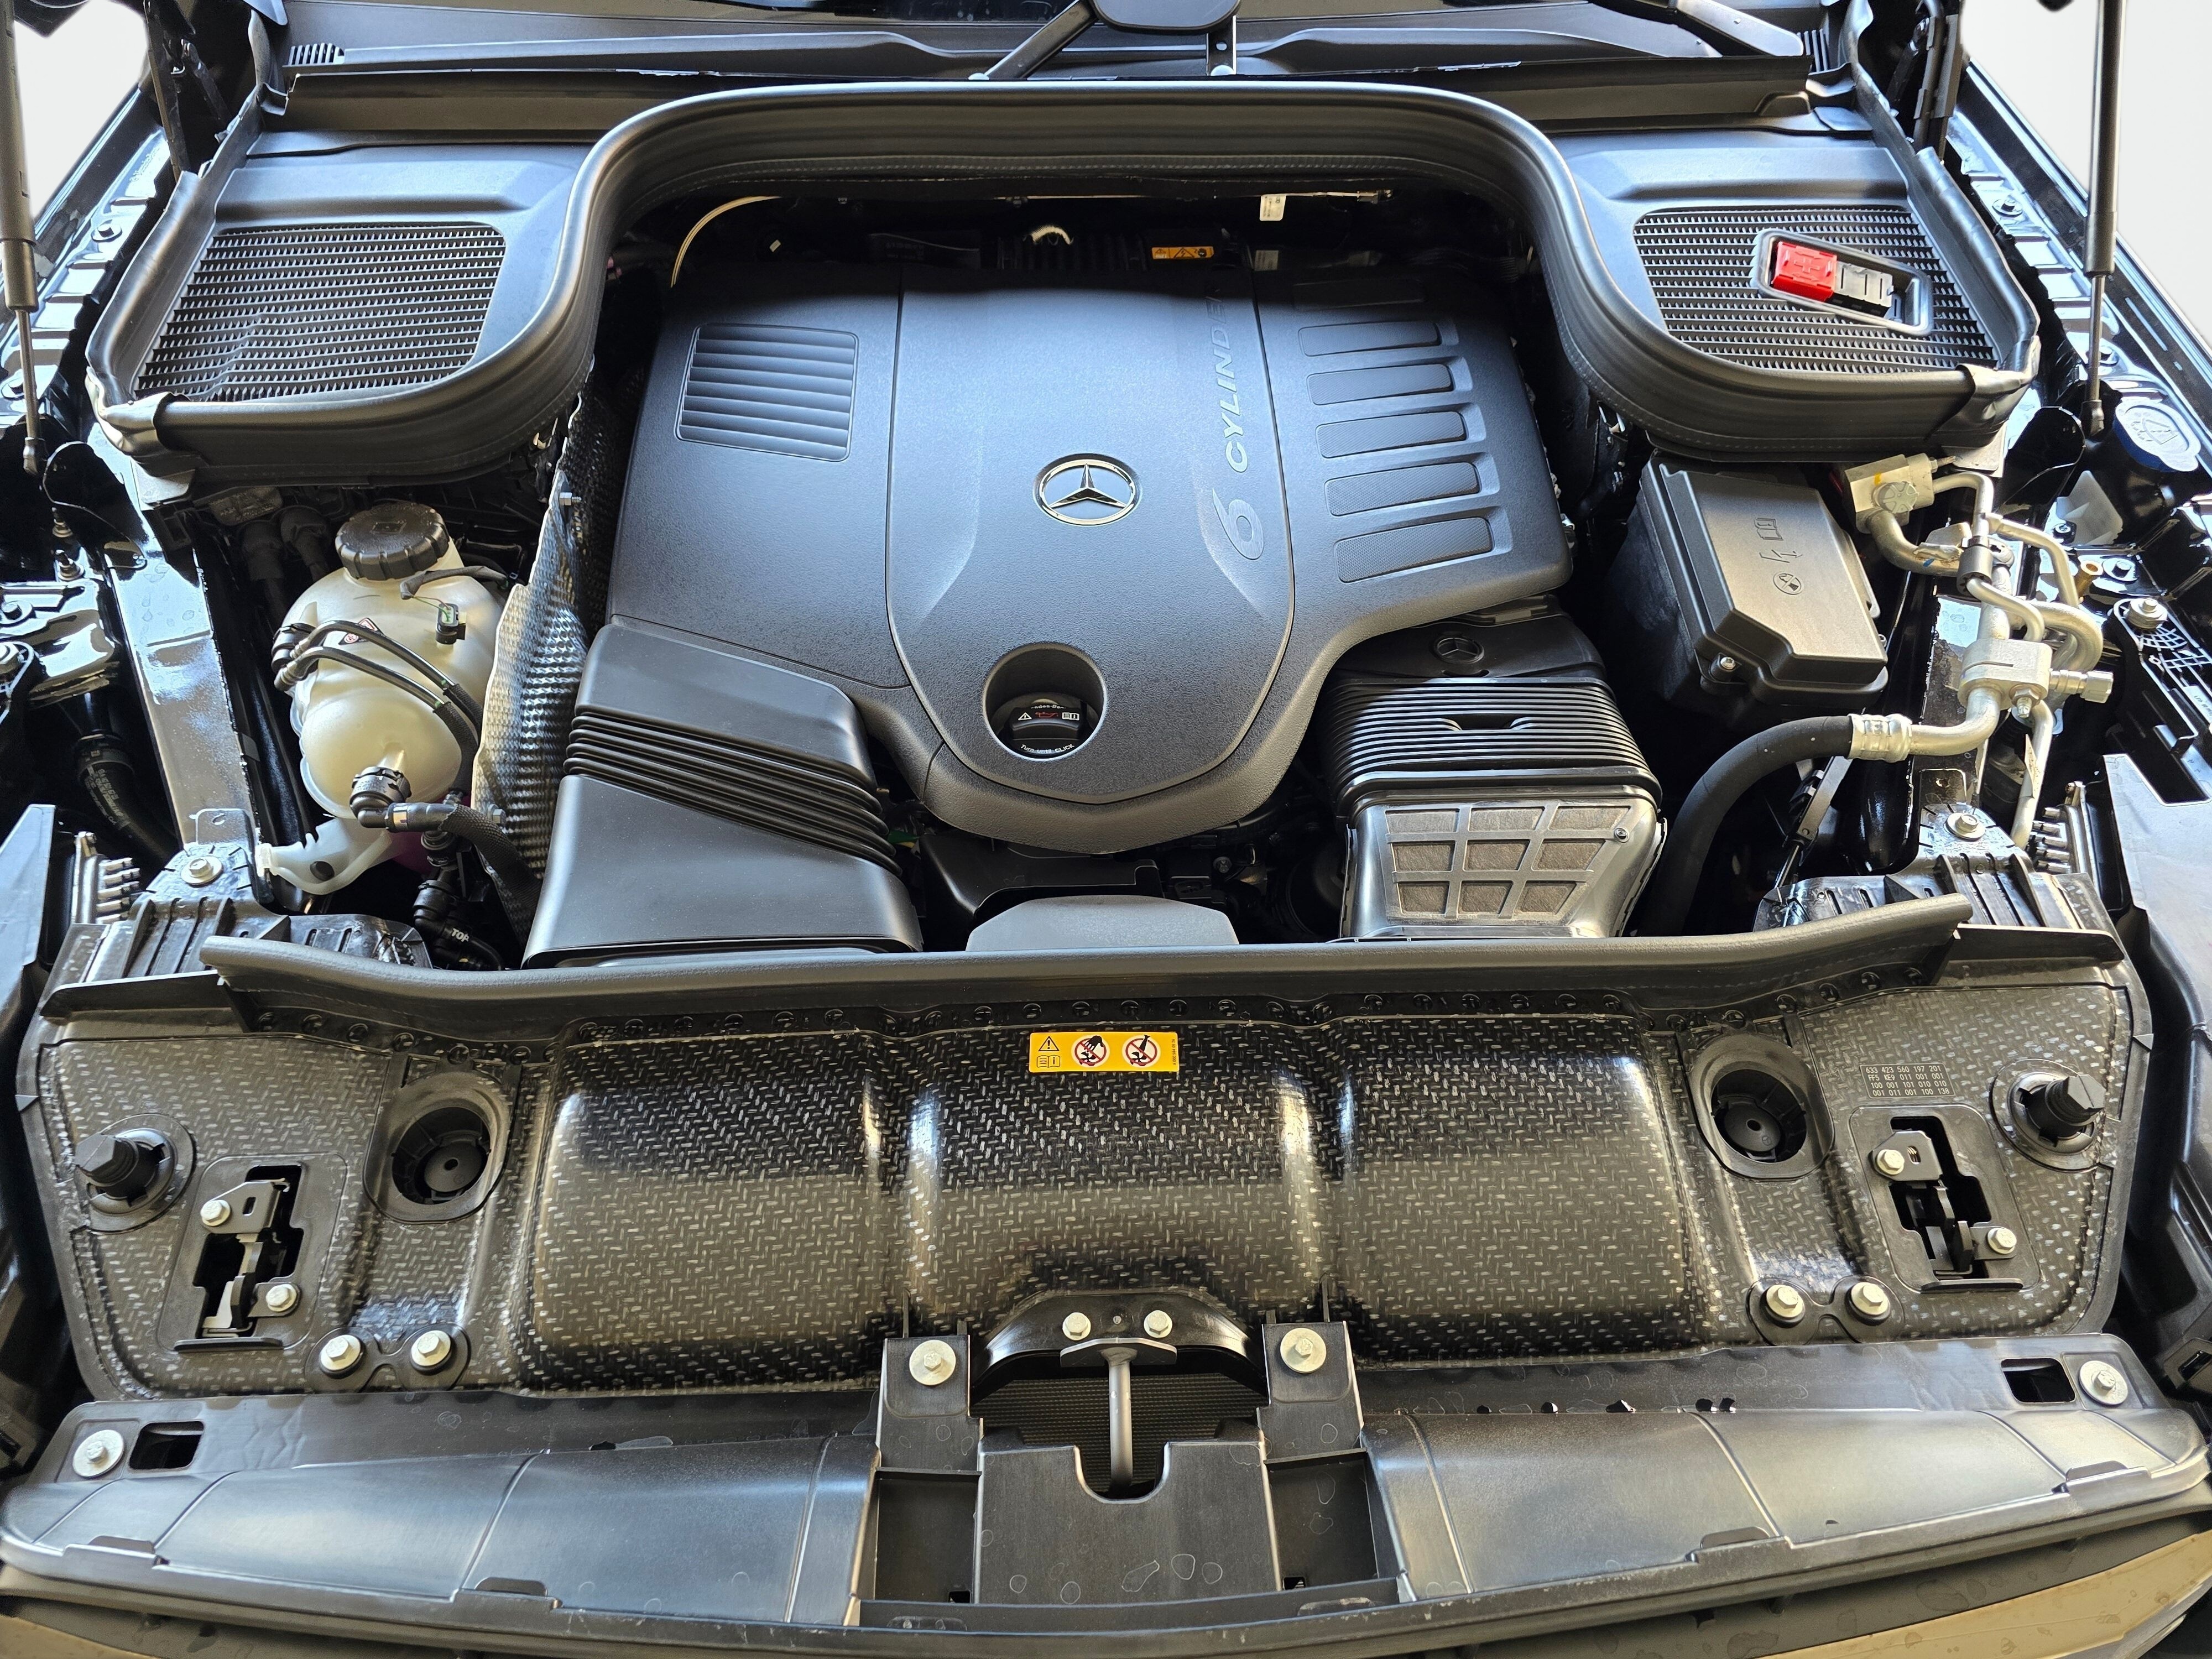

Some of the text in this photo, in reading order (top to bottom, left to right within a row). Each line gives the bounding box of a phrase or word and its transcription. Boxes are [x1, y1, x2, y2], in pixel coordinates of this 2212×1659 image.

[1212, 488, 1265, 561] 6
[1020, 744, 1035, 752] Turn
[1055, 743, 1074, 752] CLICK
